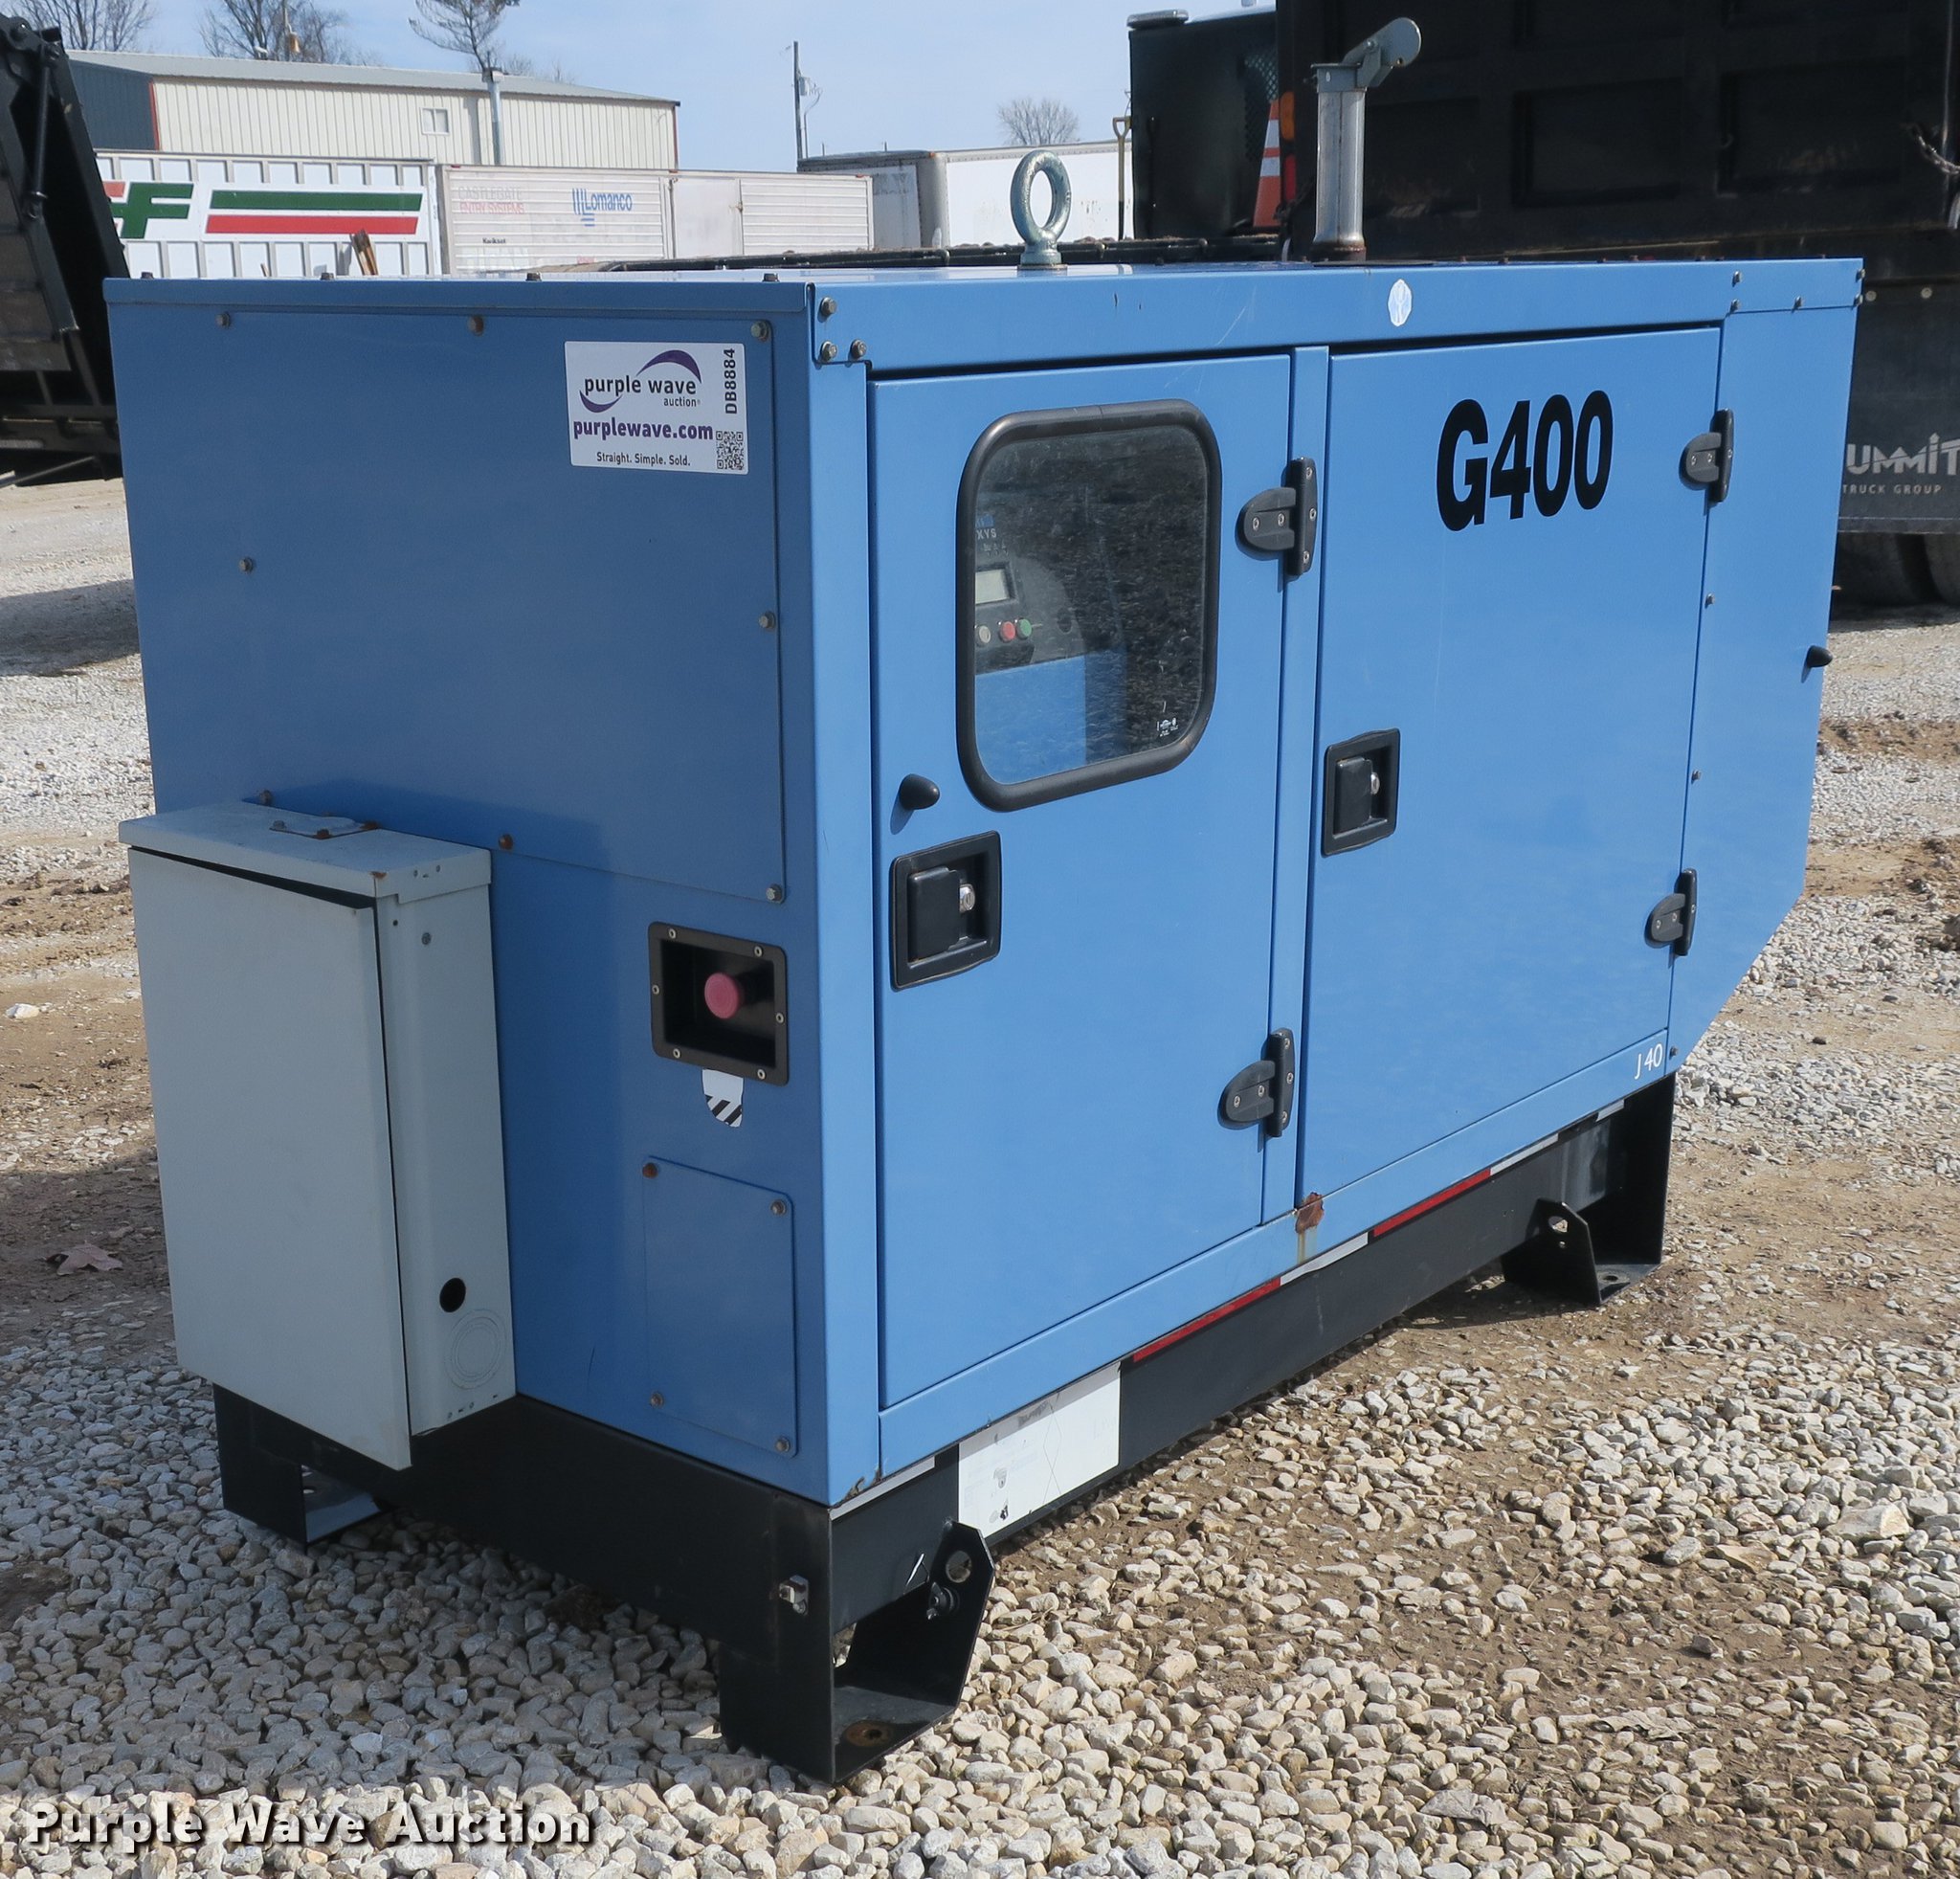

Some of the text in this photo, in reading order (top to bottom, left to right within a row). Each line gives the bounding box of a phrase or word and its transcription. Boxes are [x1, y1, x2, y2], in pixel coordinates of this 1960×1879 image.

[582, 189, 634, 212] Lomanco
[585, 375, 697, 397] purple wave
[724, 348, 738, 414] DB8884
[573, 417, 714, 441] purplewave.com
[596, 452, 691, 467] Straight. Simple. Sold.
[1437, 390, 1614, 532] G400
[1843, 484, 1942, 495] TRUCK GROUP
